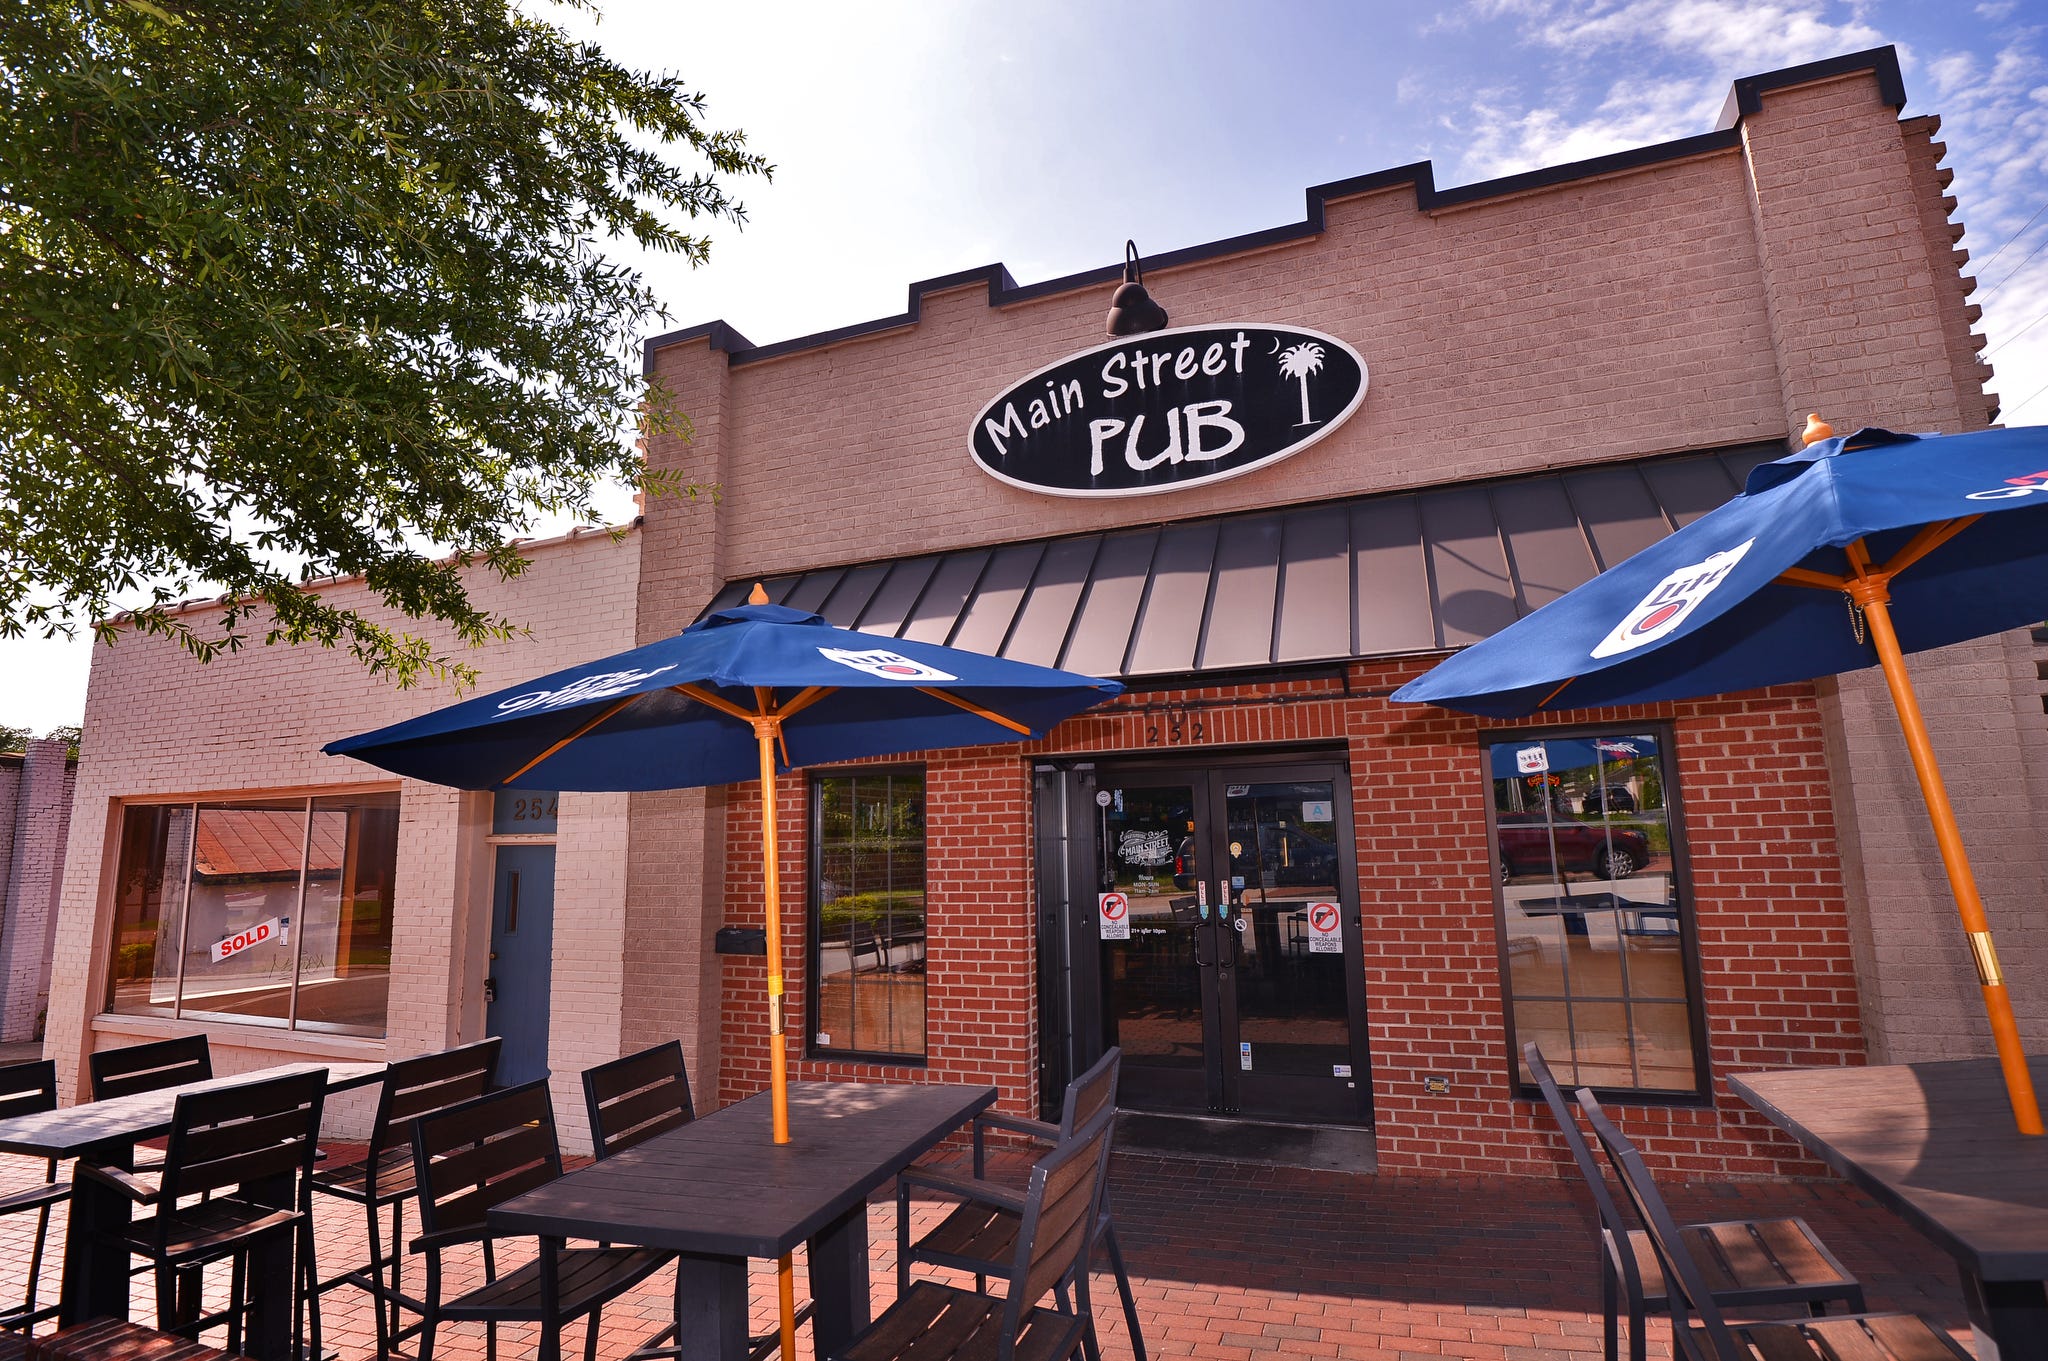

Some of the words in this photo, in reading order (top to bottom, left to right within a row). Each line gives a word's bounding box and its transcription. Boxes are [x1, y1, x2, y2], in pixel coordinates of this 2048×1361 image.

[985, 379, 1084, 455] Main
[1102, 332, 1250, 399] Street
[1090, 400, 1246, 477] PUB
[1147, 722, 1204, 743] 252
[513, 797, 558, 821] 254
[1312, 805, 1323, 816] A
[1125, 844, 1144, 857] MAIN
[1144, 838, 1169, 851] STREET
[221, 924, 269, 956] SOLD
